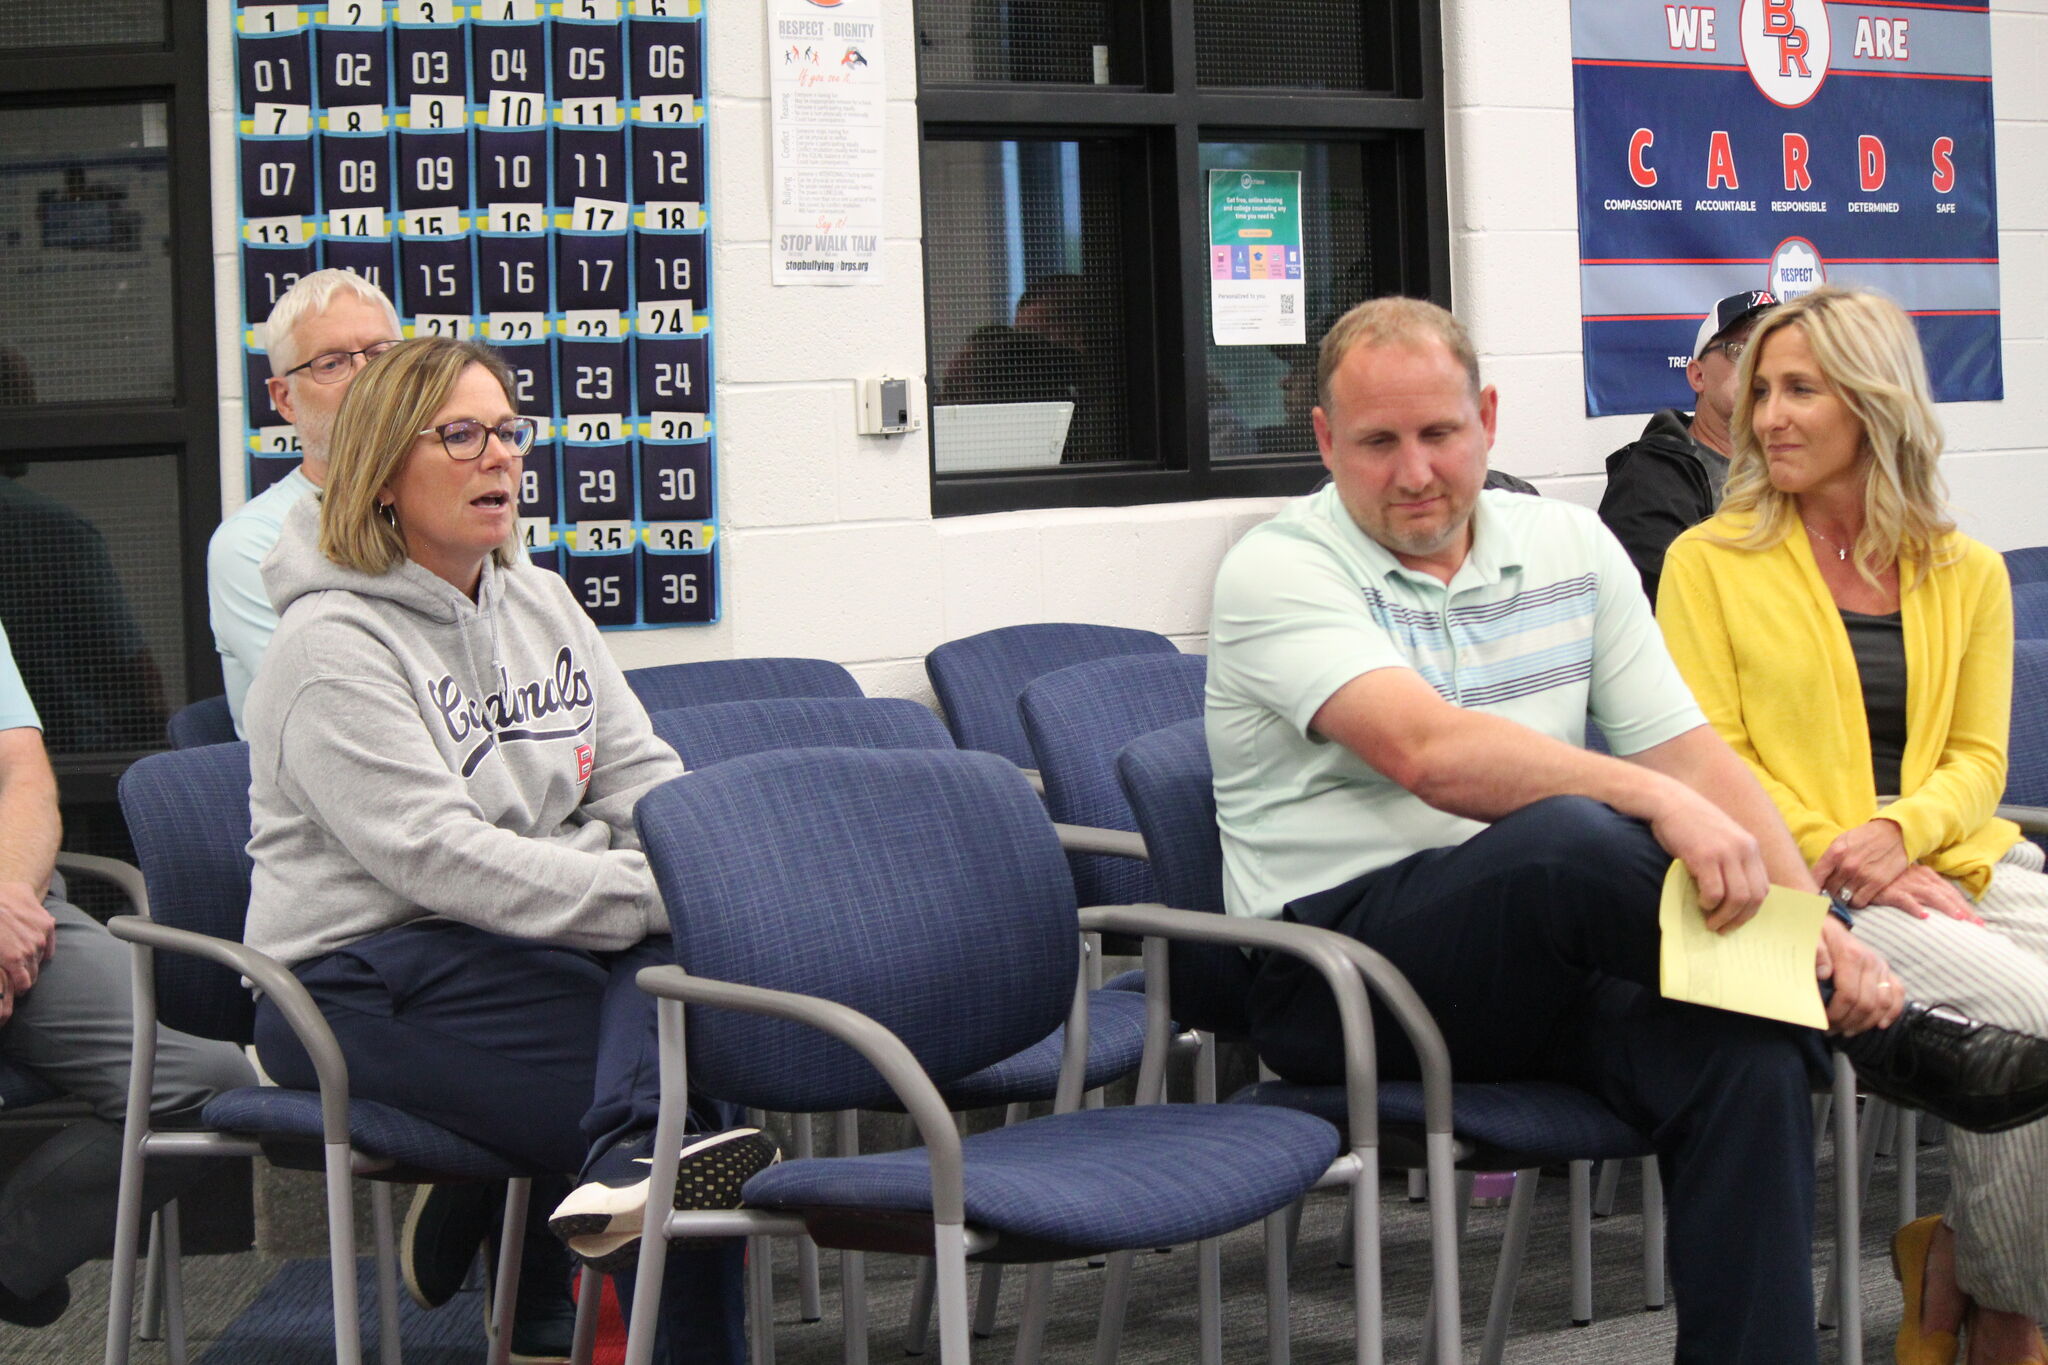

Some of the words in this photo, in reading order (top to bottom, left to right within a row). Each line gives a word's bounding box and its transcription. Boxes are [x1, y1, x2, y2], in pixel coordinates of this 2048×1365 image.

[779, 20, 824, 36] RESPECT
[834, 22, 874, 38] DIGNITY
[1664, 5, 1716, 50] WE
[1853, 16, 1909, 61] ARE
[254, 58, 291, 92] 01
[336, 53, 371, 86] 02
[412, 51, 448, 84] 03
[491, 49, 527, 81] 04
[569, 47, 605, 80] 05
[649, 45, 685, 78] 06
[273, 108, 287, 135] 7
[429, 101, 443, 129] 9
[501, 96, 531, 126] 10
[574, 104, 602, 124] 11
[260, 162, 296, 196] 07
[339, 160, 376, 193] 08
[416, 156, 453, 191] 09
[494, 155, 531, 188] 10
[574, 153, 607, 187] 11
[652, 150, 688, 184] 12
[585, 207, 614, 230] 17
[1604, 199, 1682, 211] COMPASSIONATE
[1695, 201, 1756, 211] ACCOUNTABLE
[1771, 201, 1827, 212] RESPONSIBLE
[1848, 202, 1899, 213] DETERMINED
[1936, 203, 1956, 213] SAFE
[781, 234, 812, 251] STOP
[815, 235, 848, 251] WALK
[851, 235, 877, 252] TALK
[420, 264, 456, 296] 15
[499, 261, 534, 293] 16
[578, 260, 613, 291] 17
[655, 258, 690, 290] 18
[1780, 267, 1813, 282] RESPECT
[651, 309, 683, 333] 24
[576, 366, 613, 399] 23
[655, 363, 691, 396] 24
[579, 469, 616, 503] 29
[658, 468, 695, 501] 30
[589, 528, 622, 550] 35
[584, 576, 620, 608] 35
[662, 573, 697, 604] 36
